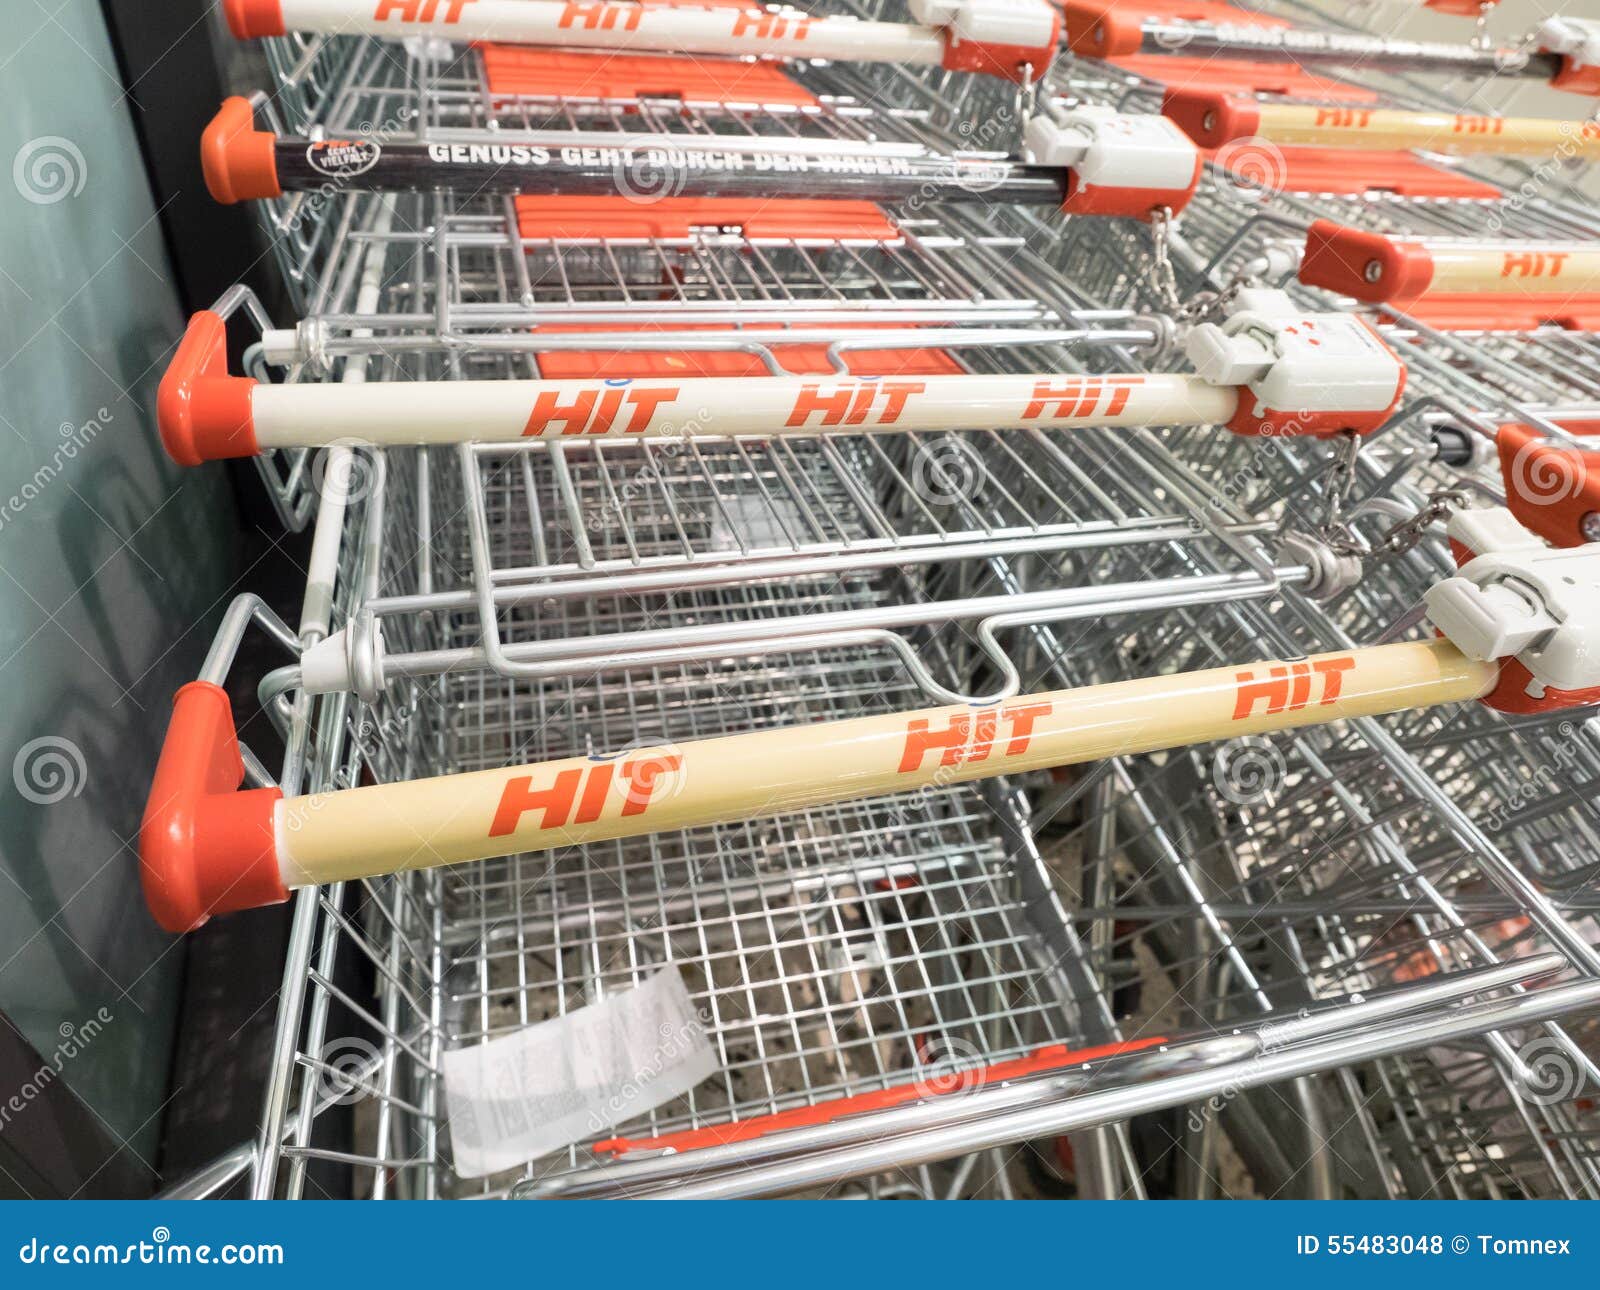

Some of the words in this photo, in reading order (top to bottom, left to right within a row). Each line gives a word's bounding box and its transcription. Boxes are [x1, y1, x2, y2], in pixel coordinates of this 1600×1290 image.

[374, 0, 478, 24] HIT
[558, 2, 655, 31] HIT
[732, 13, 824, 40] HIT
[1315, 109, 1376, 128] HIT
[1453, 114, 1505, 135] HIT
[428, 144, 551, 166] GENUSS
[560, 146, 637, 168] GEHT
[648, 148, 743, 170] DURCH
[754, 152, 809, 173] DEN
[1501, 251, 1569, 278] HIT
[521, 388, 680, 436] HIT
[785, 382, 926, 427] HIT
[1020, 377, 1145, 419] HIT
[488, 754, 684, 838] HIT
[897, 701, 1052, 773] HIT
[1231, 656, 1355, 721] HIT
